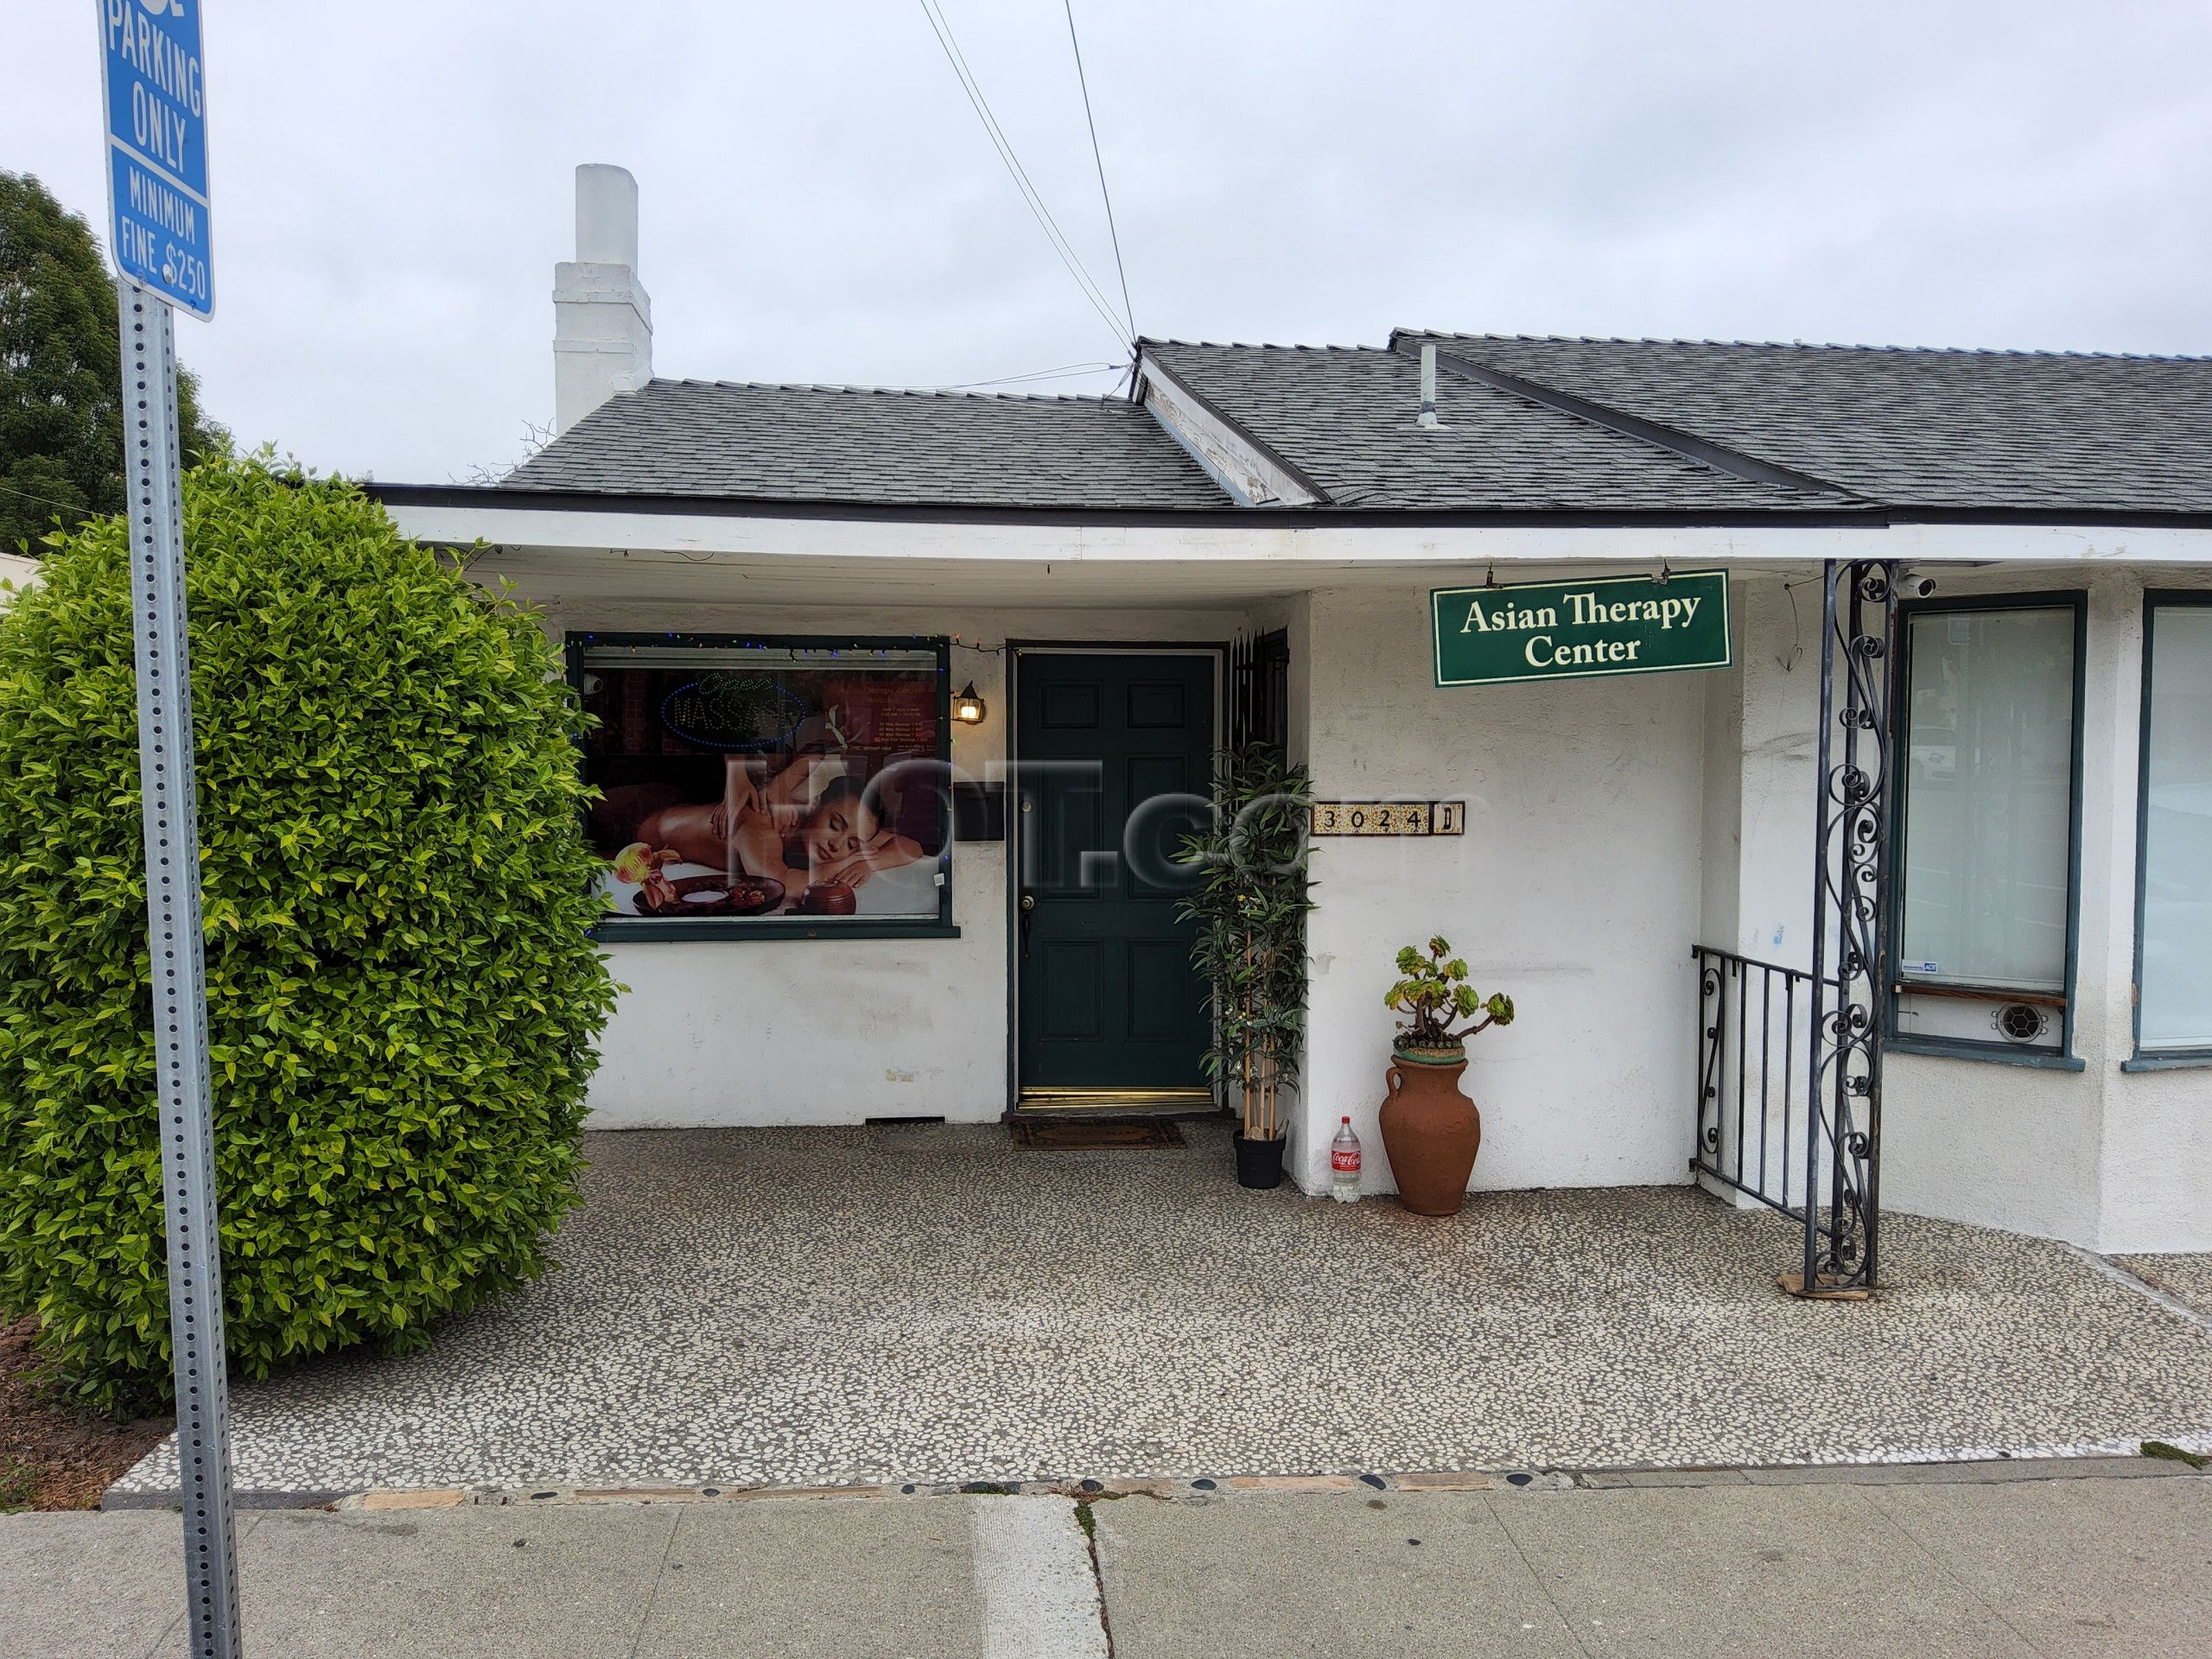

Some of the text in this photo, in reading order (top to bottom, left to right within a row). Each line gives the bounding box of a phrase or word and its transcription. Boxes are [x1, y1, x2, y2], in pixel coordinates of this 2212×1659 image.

[106, 0, 201, 118] PARKING
[133, 81, 187, 174] ONLY
[130, 165, 195, 245] MINIMUM
[122, 215, 206, 301] FINE $250
[1459, 591, 1702, 633] Asian Therapy
[1524, 635, 1642, 668] Center
[675, 696, 794, 730] MASSAGE
[1324, 809, 1421, 829] 3024
